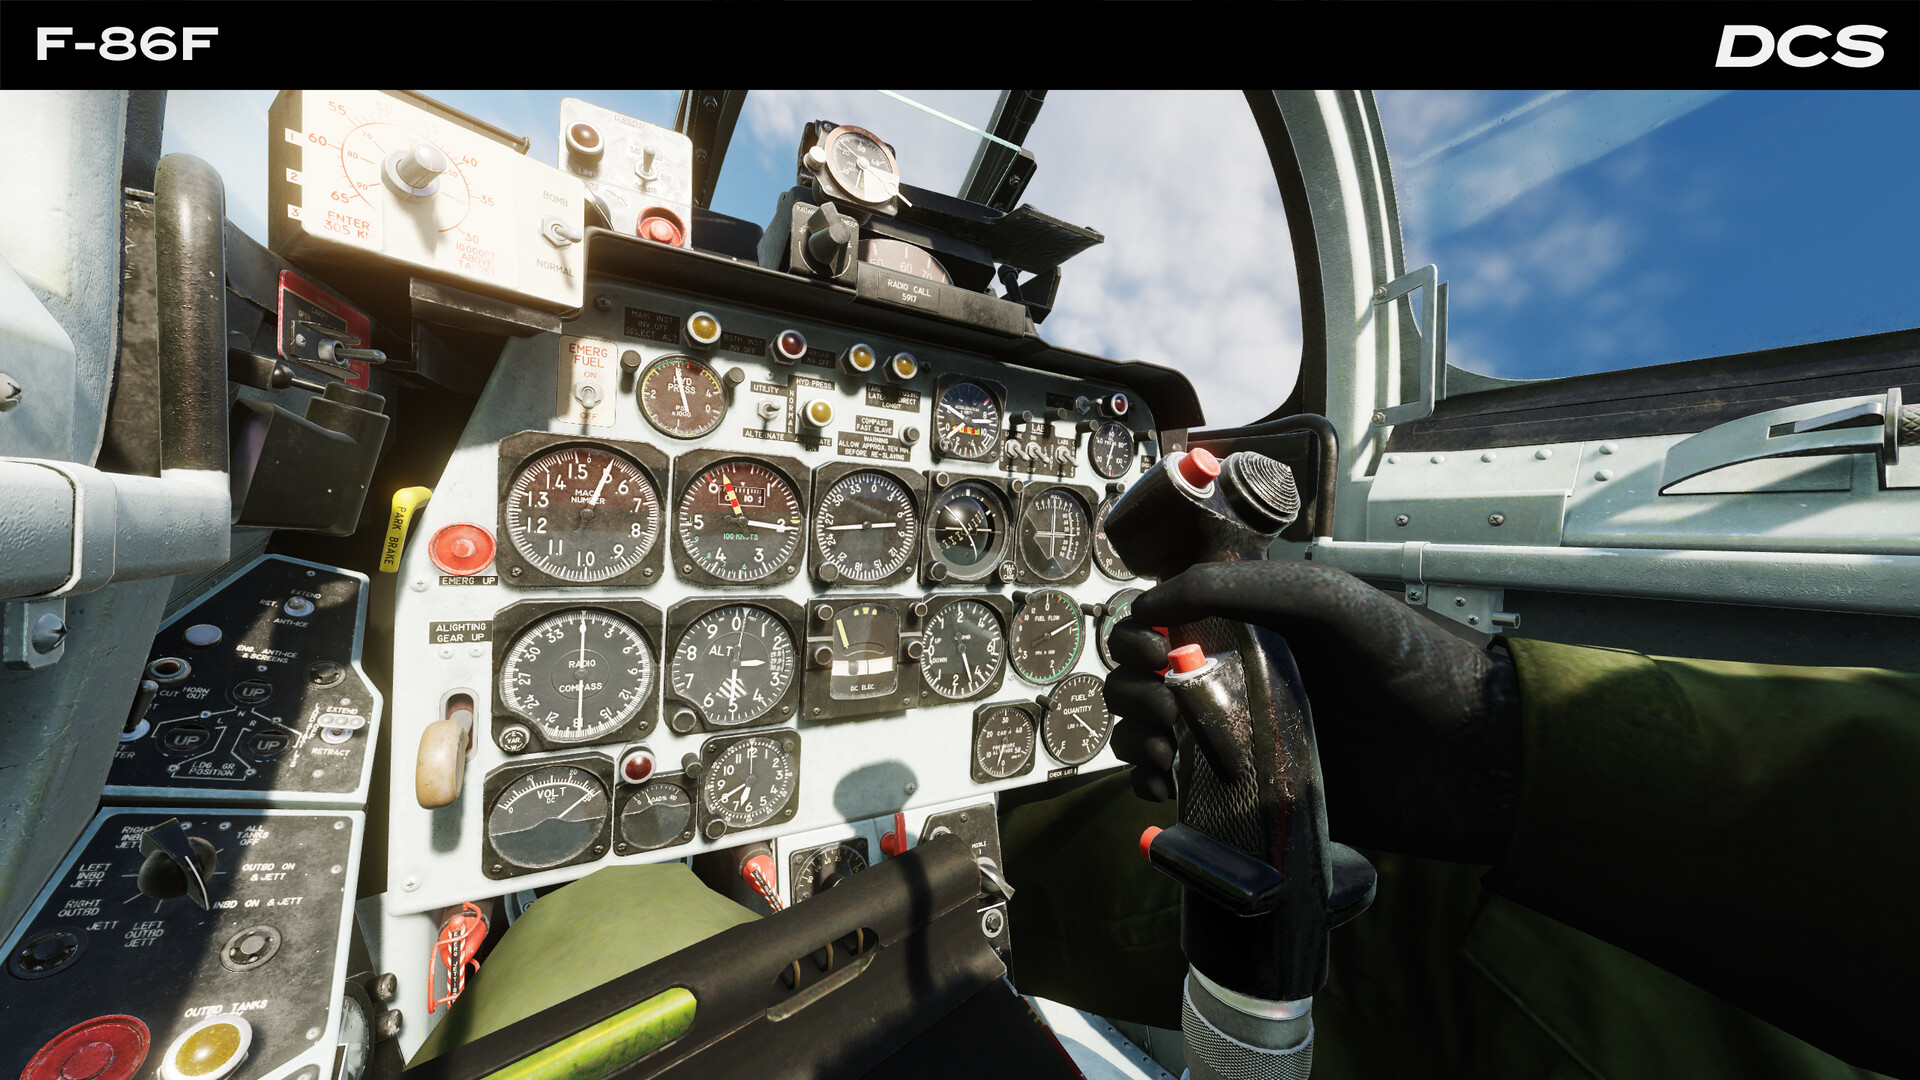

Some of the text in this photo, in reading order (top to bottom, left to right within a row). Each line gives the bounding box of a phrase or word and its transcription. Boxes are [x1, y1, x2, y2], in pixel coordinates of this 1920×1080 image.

[328, 101, 347, 117] 55
[308, 132, 327, 147] 60
[347, 151, 358, 159] 80
[462, 154, 479, 168] 40
[290, 172, 298, 181] 2
[357, 182, 368, 190] 90
[331, 191, 349, 204] 65
[480, 194, 496, 207] 35
[543, 190, 569, 208] BOMB
[291, 208, 300, 217] 3
[328, 211, 370, 230] ENTER
[324, 220, 351, 236] 305
[465, 233, 480, 244] 30
[461, 252, 492, 267] ABOVE
[537, 259, 575, 278] NORMAL
[900, 261, 912, 274] 60
[887, 279, 932, 297] RADIO CALL
[901, 292, 917, 303] 5917
[631, 310, 674, 324] MAIN INST
[639, 321, 669, 331] INV OFF
[626, 327, 656, 338] SELECT
[723, 334, 742, 343] BOTH
[569, 343, 608, 358] EMERG
[574, 354, 605, 369] FUEL
[584, 370, 597, 379] ON
[673, 376, 692, 387] HYD
[796, 378, 835, 391] HYD PRESS.
[668, 385, 696, 395] PRESS
[753, 385, 780, 395] UTILITY
[579, 412, 597, 420] OFF
[861, 417, 888, 426] COMPASS
[874, 426, 893, 434] SLAVE
[745, 432, 785, 441] ALTERNATE
[863, 435, 889, 445] WARNING
[839, 440, 860, 448] ALLOW
[862, 443, 887, 451] APPROX.
[845, 449, 905, 460] BEFORE RE-SLAVING
[568, 463, 588, 479] 1.5
[546, 472, 566, 490] 1.4
[528, 490, 549, 507] 1.3
[575, 489, 600, 497] MAC
[571, 496, 606, 504] NUMER
[832, 494, 844, 507] 30
[392, 506, 406, 530] PARK
[825, 513, 834, 525] 27
[527, 516, 548, 533] 1.2
[827, 533, 836, 546] 24
[384, 536, 399, 565] BRAKE
[549, 539, 563, 555] 1.1
[888, 547, 898, 557] 12
[577, 551, 595, 567] 1.0
[837, 551, 848, 561] 21
[854, 561, 863, 571] 18
[873, 559, 882, 569] 15
[442, 577, 496, 585] EMERG UP
[290, 588, 322, 599] EXTEND
[259, 599, 278, 608] RET.
[272, 617, 309, 628] ANTI-ICE
[436, 622, 486, 632] ALIGHTING
[731, 616, 741, 631] 0
[546, 629, 564, 643] 33
[706, 624, 718, 639] 9
[437, 633, 484, 642] GEAR UP
[772, 635, 782, 650] 2
[525, 647, 541, 662] 30
[686, 645, 697, 661] 8
[708, 644, 733, 657] ALT
[249, 654, 289, 663] SCREENS
[568, 659, 596, 669] RADIO
[518, 672, 531, 685] 27
[684, 673, 695, 689] 7
[769, 671, 780, 686] 3
[159, 689, 180, 697] CUT
[182, 686, 210, 695] HORN
[242, 687, 266, 697] UP
[558, 682, 603, 693] COMASS
[618, 689, 632, 701] 12
[703, 692, 714, 707] 6
[752, 688, 763, 702] 4
[524, 694, 540, 710] 24
[728, 698, 738, 712] 5
[326, 707, 358, 715] EXTEND
[600, 707, 613, 718] 15
[1063, 705, 1092, 715] QUANTITY
[545, 711, 559, 723] 21
[173, 735, 200, 745] UP
[256, 740, 280, 750] UP
[310, 747, 352, 756] RETRACT
[735, 753, 742, 764] 11
[192, 761, 213, 769] LDG
[723, 764, 735, 776] 10
[1049, 771, 1062, 779] CHECK
[537, 787, 566, 799] VOLT
[237, 831, 269, 839] TANKS
[239, 838, 260, 846] OFF
[79, 863, 112, 871] LEFT
[241, 862, 296, 872] OUTBD ON
[76, 871, 105, 880] INBD
[250, 873, 287, 882] & JETT
[70, 879, 103, 888] JETT
[64, 899, 103, 909] RIGHT
[212, 897, 303, 909] INBD ON & JETT
[57, 907, 100, 917] OUTBD
[86, 920, 119, 931] JETT
[132, 920, 166, 930] LEFT
[124, 929, 165, 940] OUTBD
[123, 938, 157, 948] JETT
[184, 1000, 268, 1017] OUTBD TANKS
